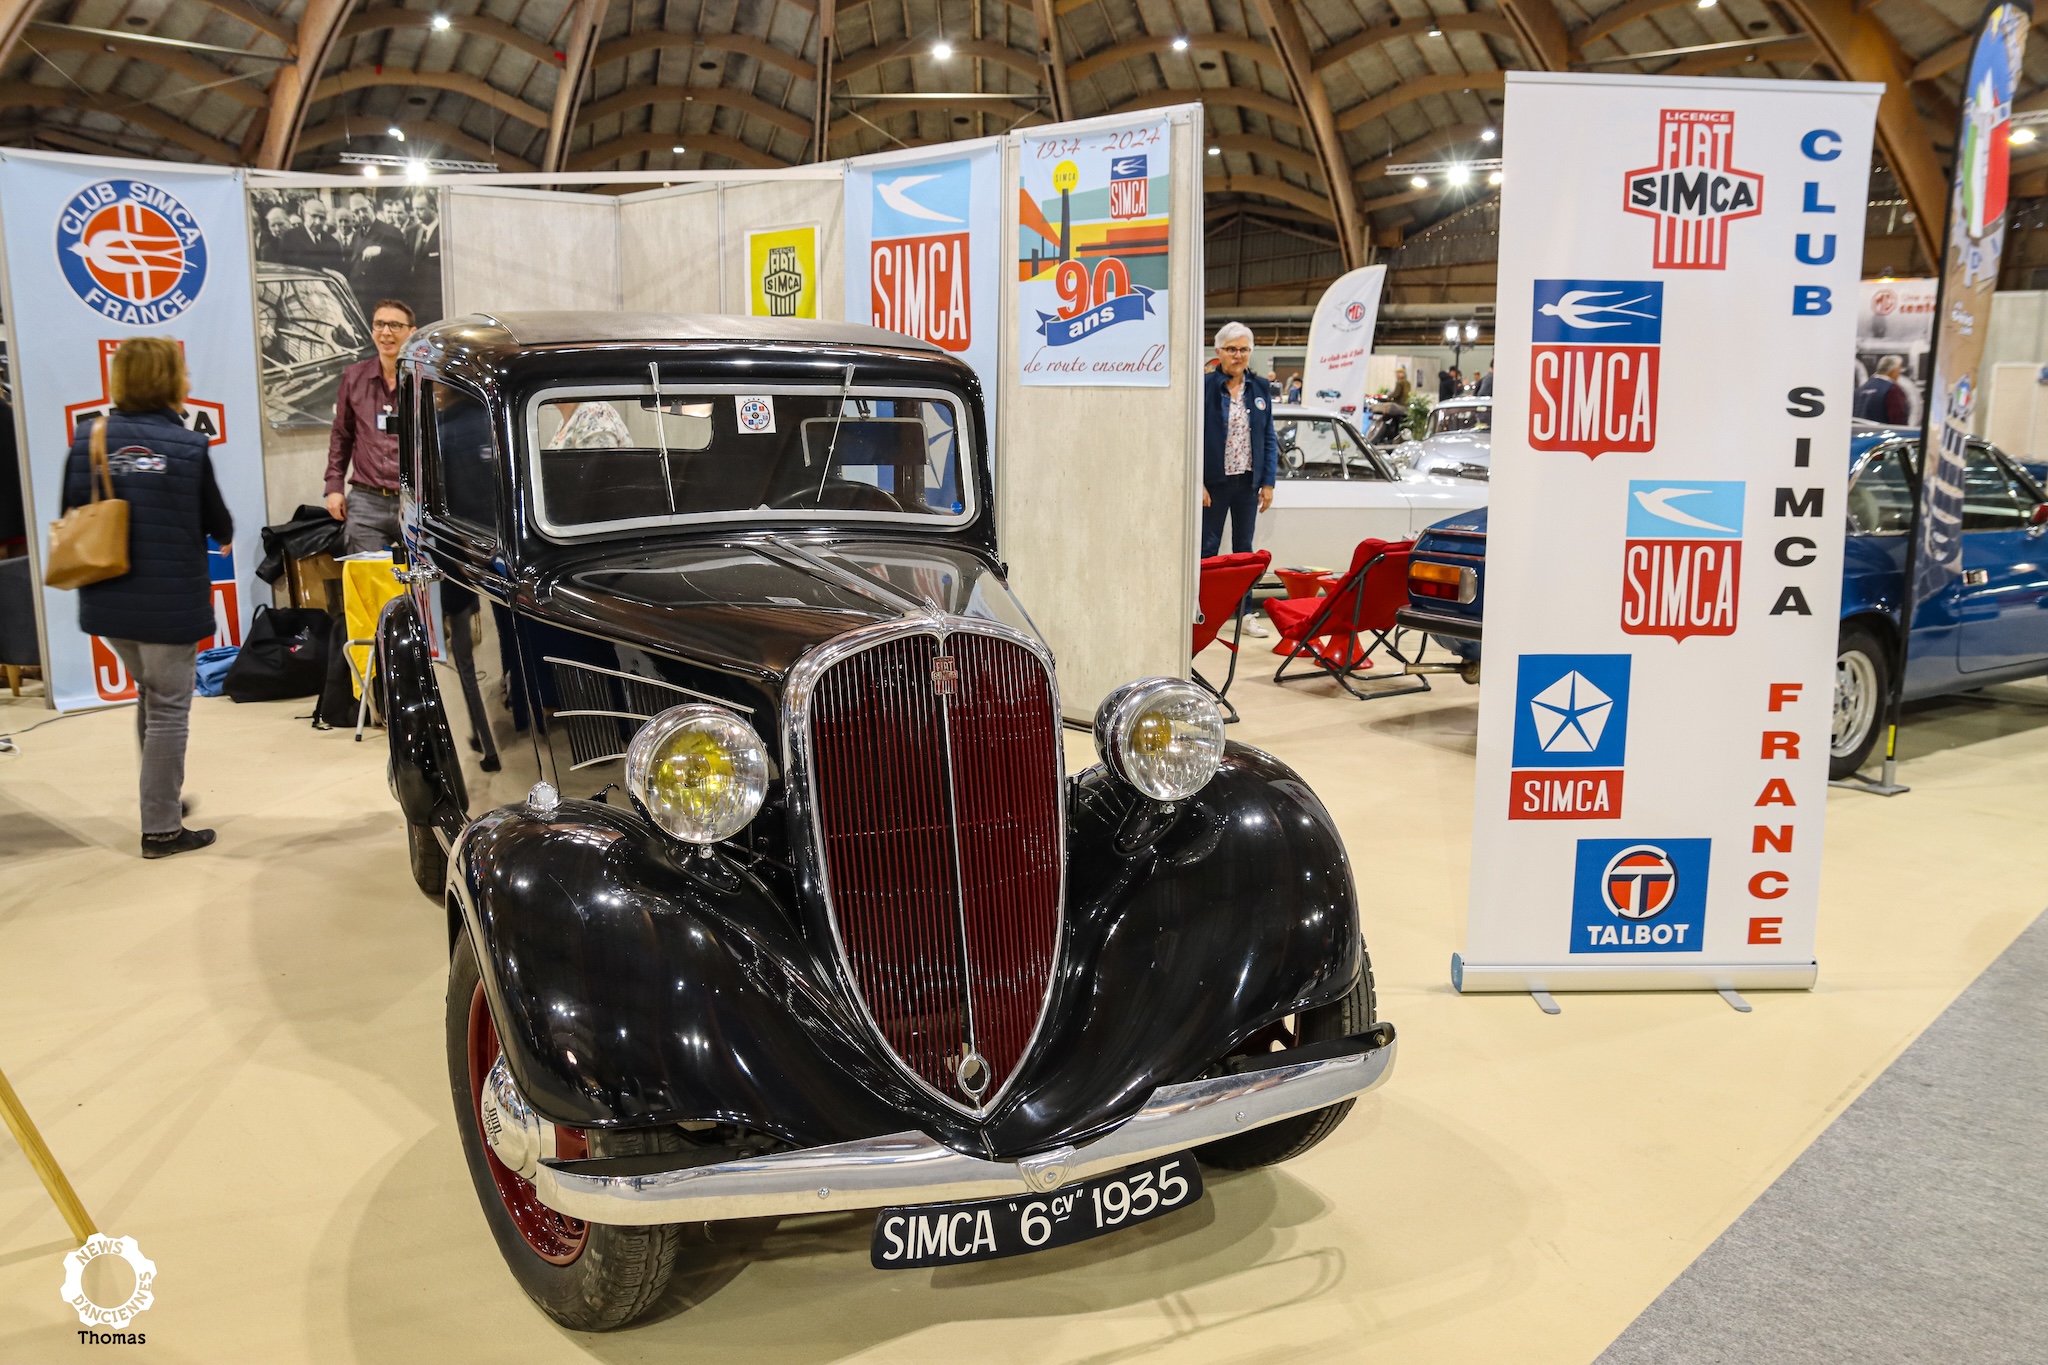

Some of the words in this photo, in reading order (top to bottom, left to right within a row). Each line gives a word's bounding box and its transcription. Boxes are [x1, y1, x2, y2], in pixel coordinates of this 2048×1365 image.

[1666, 112, 1730, 122] LICENCE
[1036, 138, 1081, 160] 1934
[1102, 127, 1160, 151] 2024
[1663, 123, 1731, 172] FIAT
[1056, 171, 1077, 182] SIMCA
[1632, 171, 1754, 216] SIMCA
[61, 182, 118, 235] CLUB
[129, 182, 201, 245] SIMCA
[1111, 180, 1146, 216] SIMCA
[1792, 129, 1843, 316] CLUB
[770, 247, 794, 255] LICENCE
[771, 253, 795, 274] FIAT
[767, 275, 799, 293] SIMCA
[874, 240, 967, 341] SIMCA
[1056, 257, 1131, 321] 90
[84, 287, 193, 324] FRANCE
[1069, 306, 1115, 338] ans
[1348, 304, 1363, 320] MG
[1023, 345, 1047, 373] de
[1046, 356, 1087, 373] route
[1092, 344, 1166, 373] ensemble
[1533, 351, 1651, 442] SIMCA
[1769, 386, 1826, 616] SIMCA
[1624, 545, 1733, 627] SIMCA
[1523, 780, 1610, 812] SIMCA
[1747, 683, 1804, 945] FRANCE
[1587, 923, 1690, 946] TALBOT
[882, 1208, 998, 1260] SIMCA
[1092, 1160, 1189, 1228] 1935
